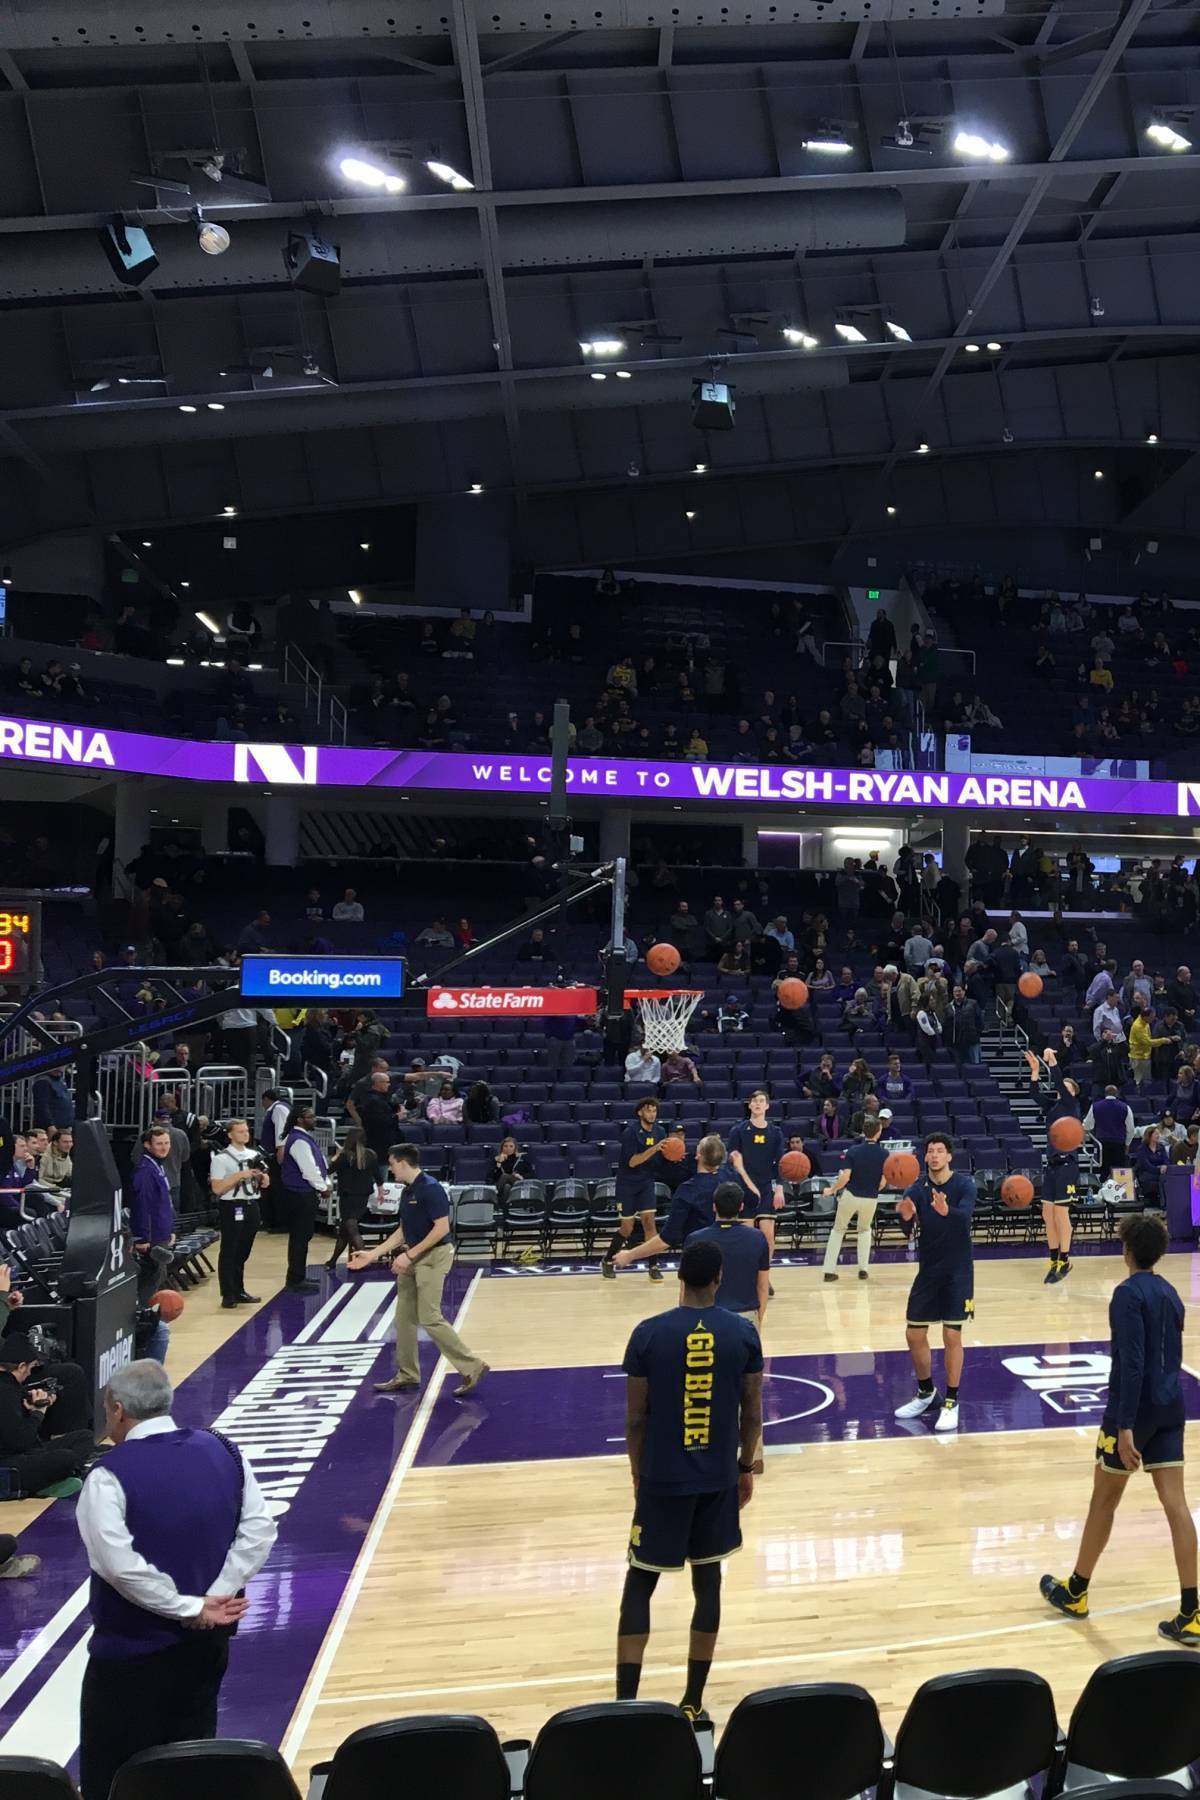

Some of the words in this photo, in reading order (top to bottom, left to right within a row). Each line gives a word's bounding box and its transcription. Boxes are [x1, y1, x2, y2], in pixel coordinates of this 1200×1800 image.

[637, 771, 671, 787] TO
[692, 765, 950, 804] WELSH-RYAN
[957, 778, 1087, 809] ARENA
[269, 969, 381, 989] Booking.com
[459, 992, 502, 1009] State
[502, 993, 544, 1009] Farm
[754, 1135, 766, 1144] M
[686, 1333, 714, 1368] GO
[684, 1372, 713, 1446] BLUE
[1097, 1429, 1117, 1454] M
